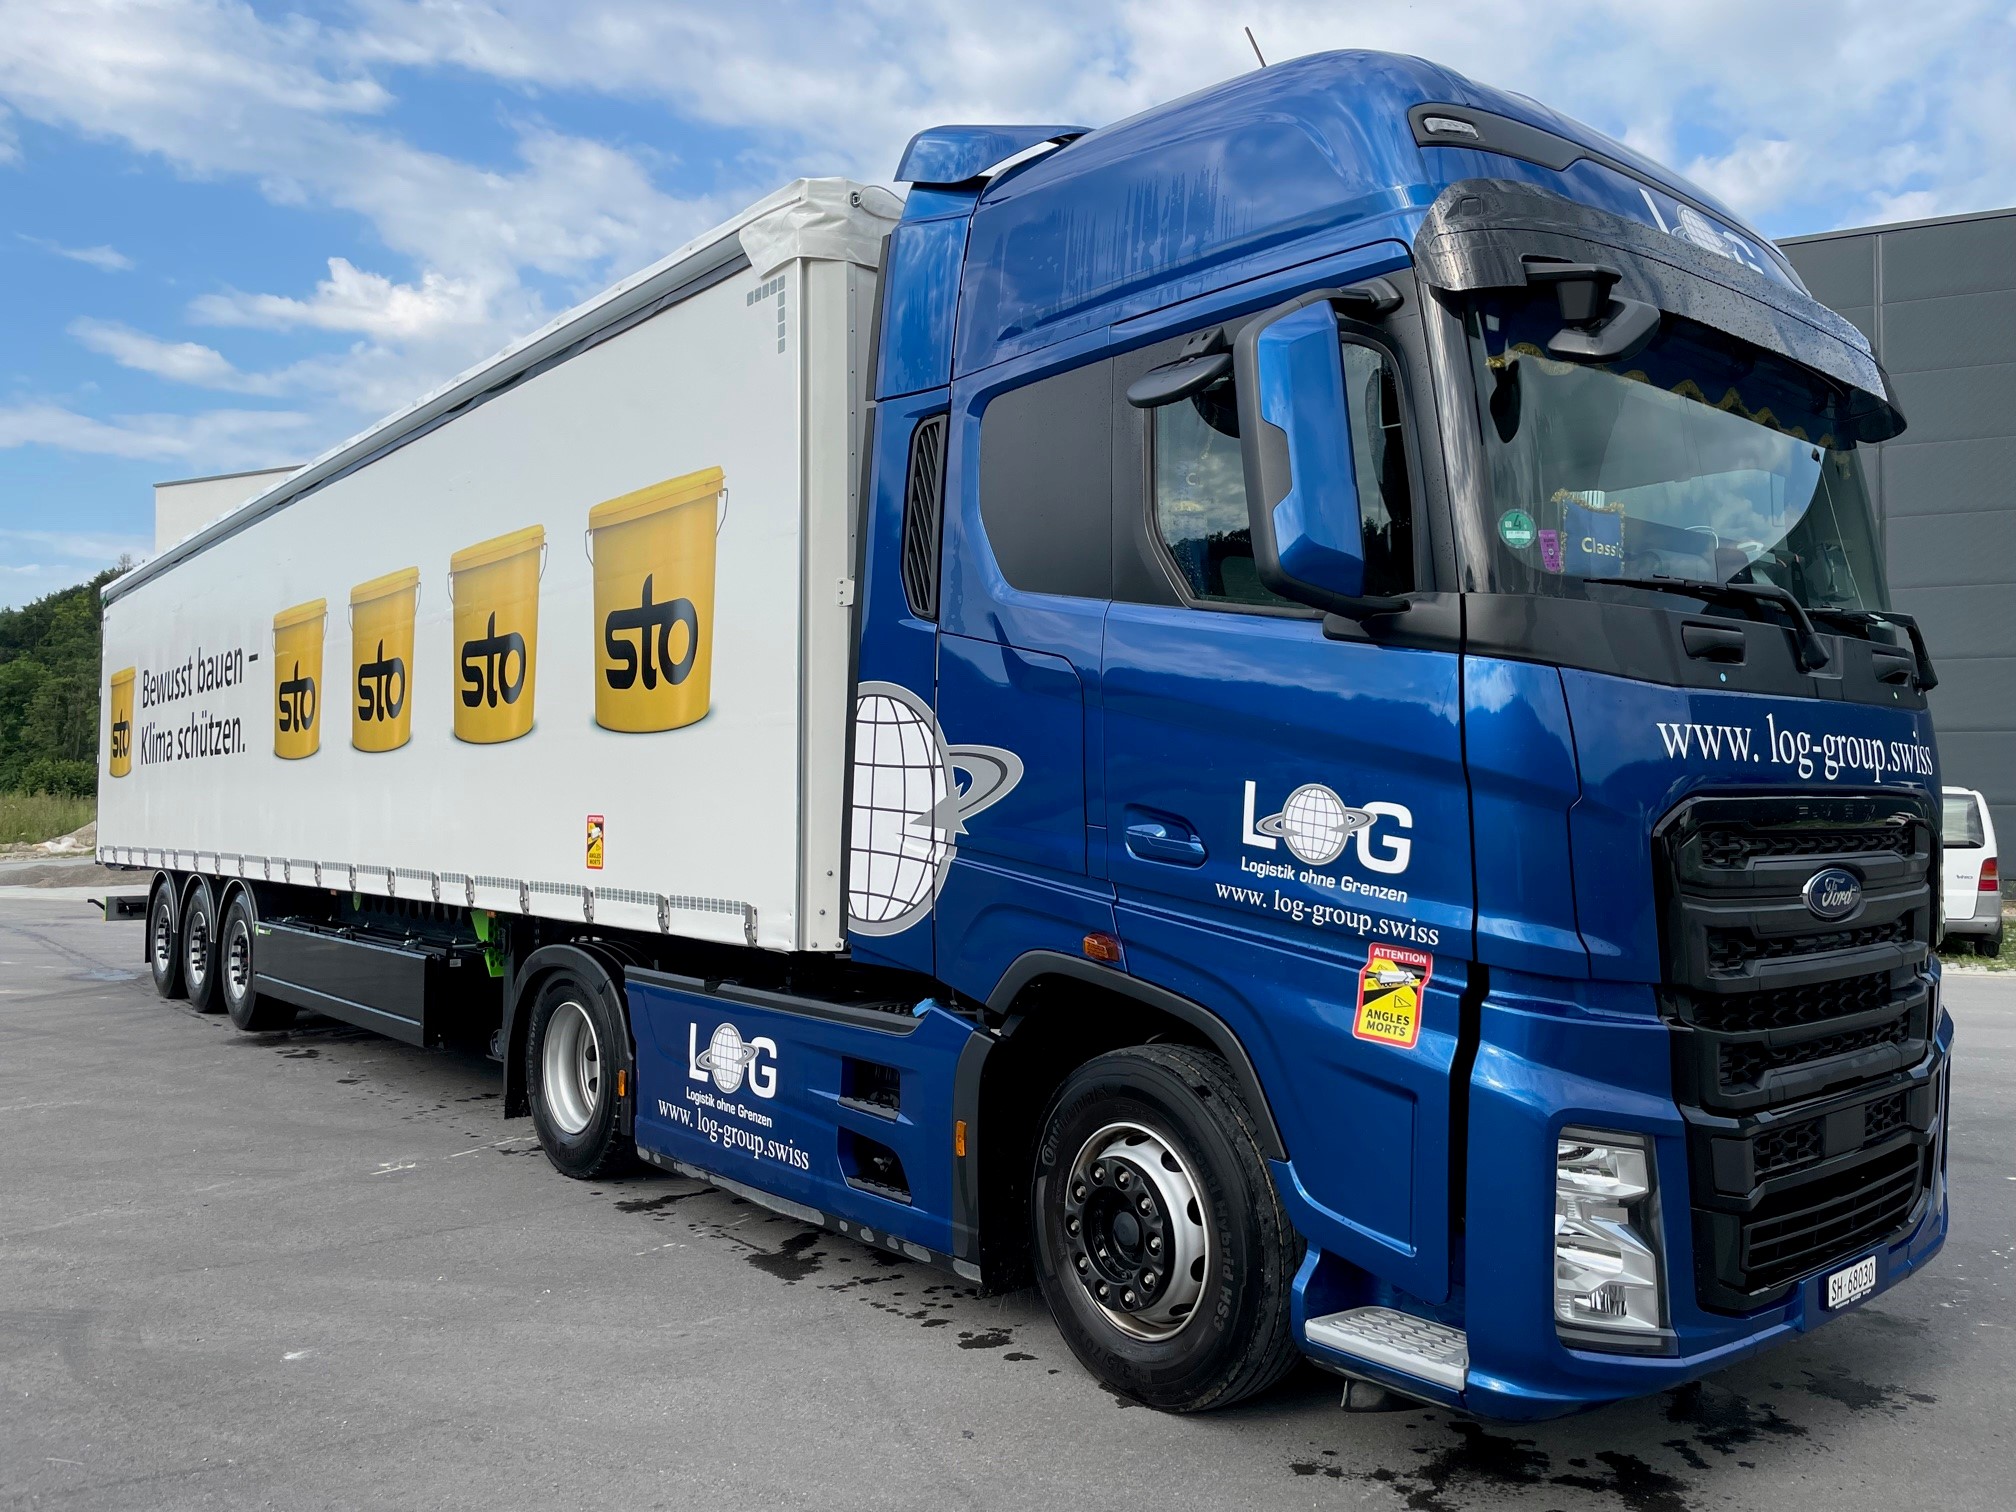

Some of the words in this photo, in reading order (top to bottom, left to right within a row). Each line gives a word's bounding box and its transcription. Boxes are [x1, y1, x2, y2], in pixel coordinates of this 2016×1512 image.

[1512, 514, 1523, 530] 4
[142, 654, 193, 709] Bewusst
[197, 647, 243, 693] bauen
[140, 723, 174, 766] Klima
[177, 709, 246, 760] schützen.
[1656, 722, 1760, 763] www.
[1766, 713, 1934, 784] log-group.swiss
[1242, 780, 1413, 875] LOG
[1240, 856, 1296, 881] Logistik
[1299, 869, 1336, 889] ohne
[1340, 876, 1408, 904] Grenzen
[1821, 876, 1856, 908] Ford
[1215, 882, 1268, 908] www.
[1273, 890, 1440, 946] log-group.swiss
[1372, 946, 1428, 964] ATTENTION
[1365, 1008, 1411, 1027] ANGLES
[1365, 1020, 1407, 1038] MORTS
[689, 1022, 777, 1100] LOG
[686, 1086, 716, 1109] Logistik
[716, 1098, 736, 1115] ohne
[737, 1103, 773, 1129] Grenzen
[657, 1099, 694, 1128] www.
[697, 1110, 809, 1171] log-group.swiss
[1212, 1284, 1234, 1333] HS3
